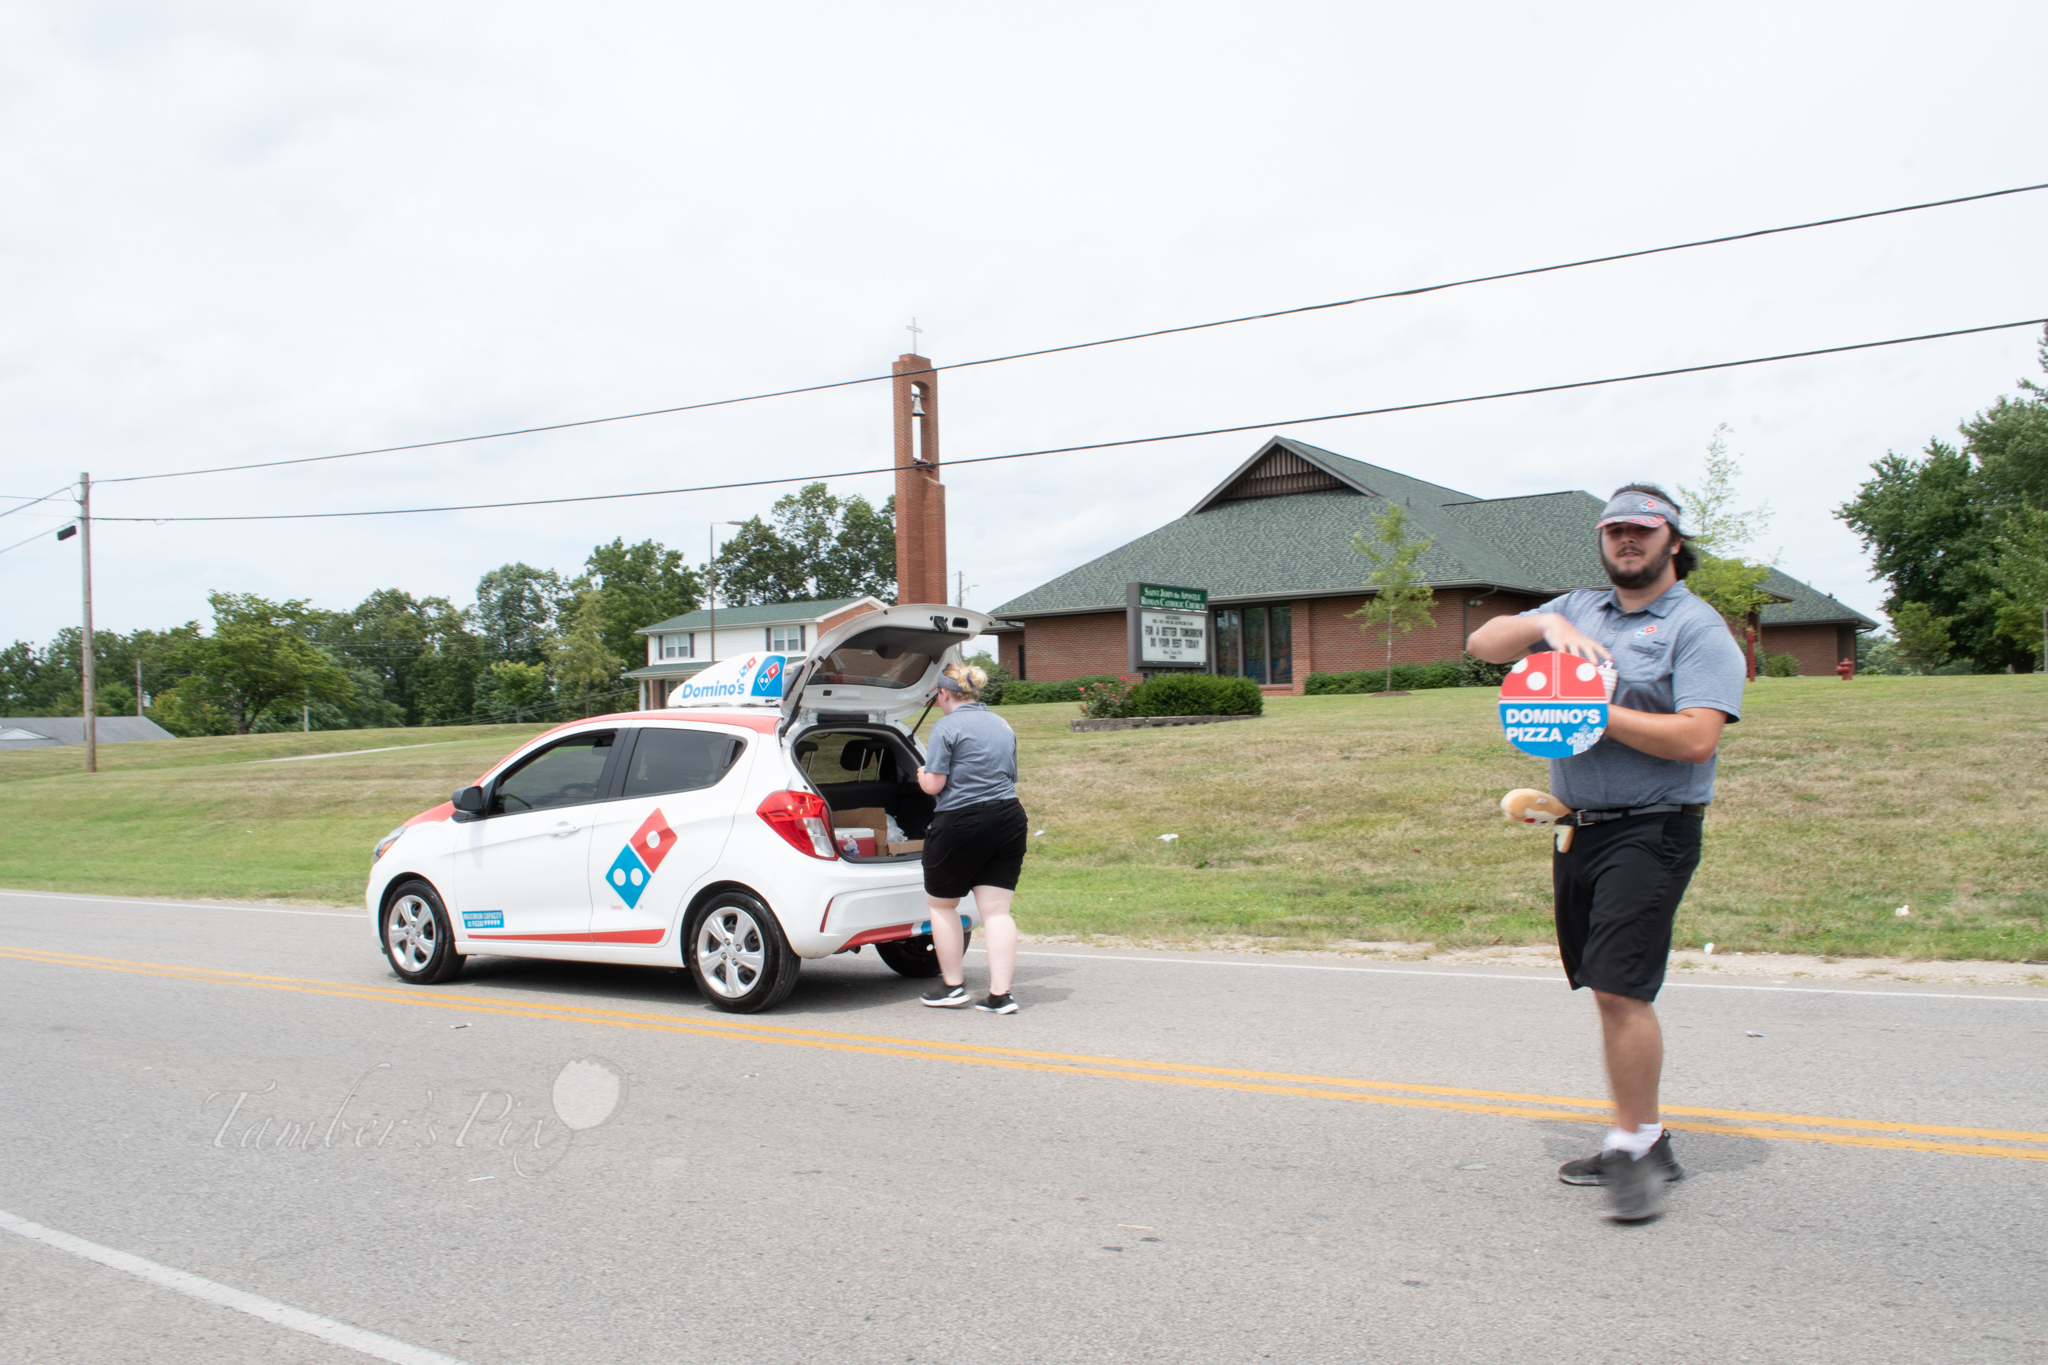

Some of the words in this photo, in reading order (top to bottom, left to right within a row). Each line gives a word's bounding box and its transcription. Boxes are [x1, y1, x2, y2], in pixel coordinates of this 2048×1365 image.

[1144, 587, 1159, 597] SAINT
[1160, 589, 1174, 598] JOHN
[1181, 591, 1201, 601] APOSTLE
[1141, 596, 1160, 606] ROMAN
[1160, 598, 1184, 608] CATHOLIC
[1185, 600, 1205, 610] CHURCH
[1145, 626, 1153, 635] FOR
[1161, 627, 1177, 636] BETTER
[1180, 628, 1203, 638] TOMORROW
[1150, 638, 1156, 647] DO
[1159, 638, 1170, 648] YOUR
[1171, 638, 1182, 648] BEST
[1185, 639, 1199, 649] TODAY
[682, 678, 745, 699] Domino's
[1506, 708, 1601, 724] DOMINO'S
[1506, 727, 1563, 742] PIZZA
